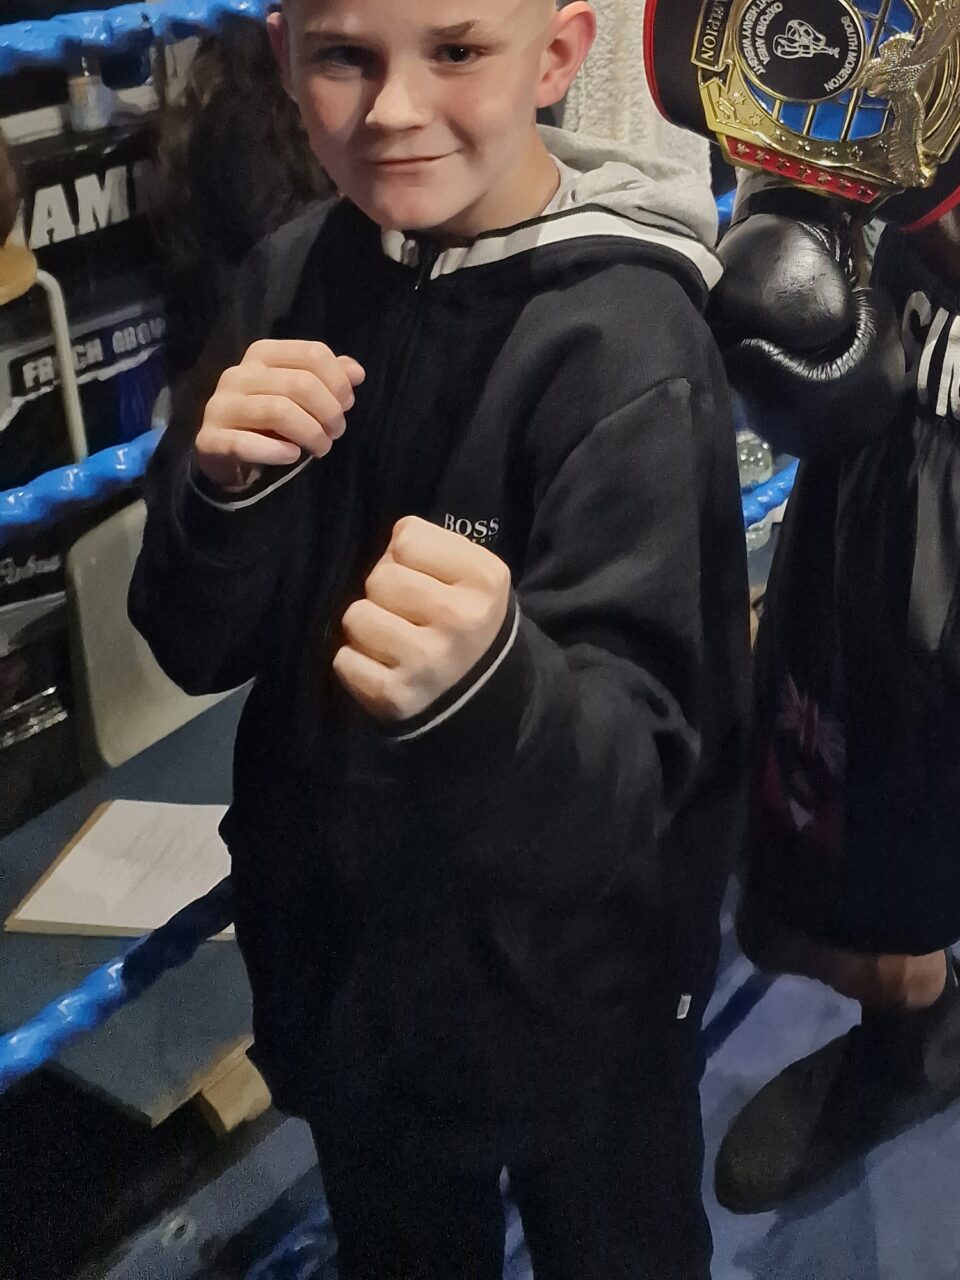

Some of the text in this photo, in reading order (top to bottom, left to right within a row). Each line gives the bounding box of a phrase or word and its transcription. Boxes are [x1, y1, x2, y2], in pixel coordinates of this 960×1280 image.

[742, 5, 760, 38] HEAVY
[755, 1, 784, 65] OXFORD AREA
[742, 38, 766, 75] WEIGHT
[824, 15, 858, 92] SOUTH MORETON
[444, 513, 500, 538] BOSS
